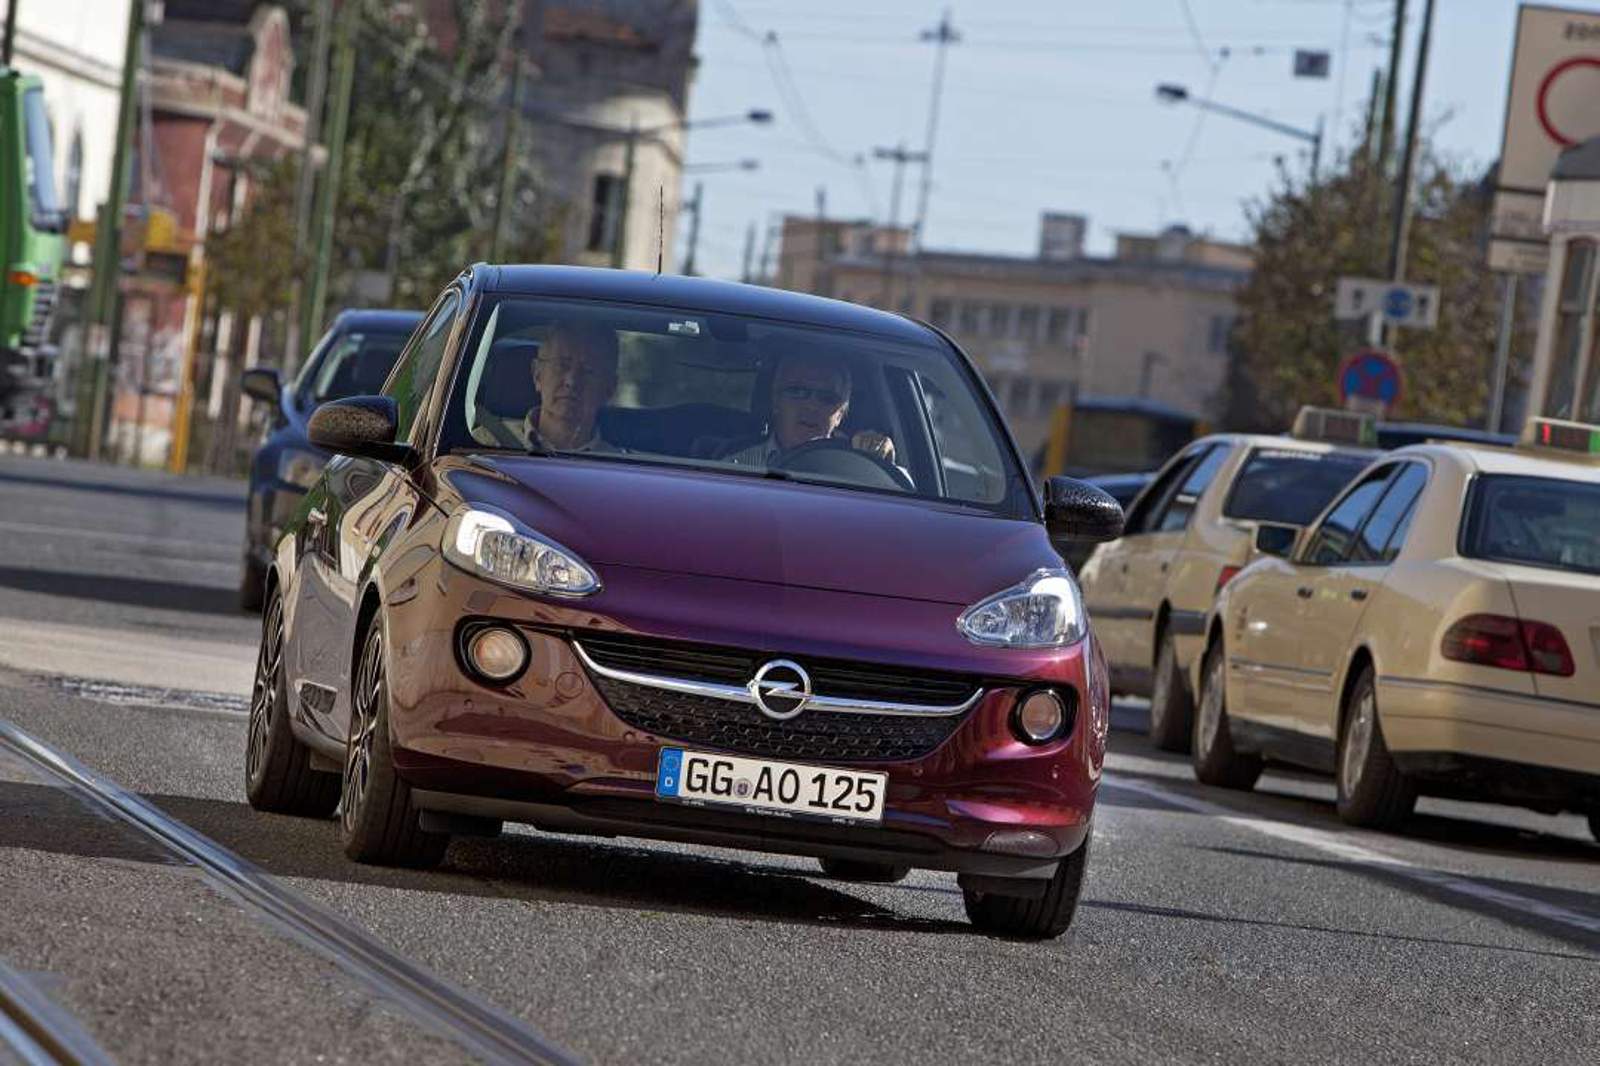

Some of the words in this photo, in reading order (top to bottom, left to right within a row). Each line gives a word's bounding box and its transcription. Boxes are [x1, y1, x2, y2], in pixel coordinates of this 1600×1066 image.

[686, 757, 734, 796] GG
[752, 766, 801, 804] AO
[808, 773, 878, 813] 125
